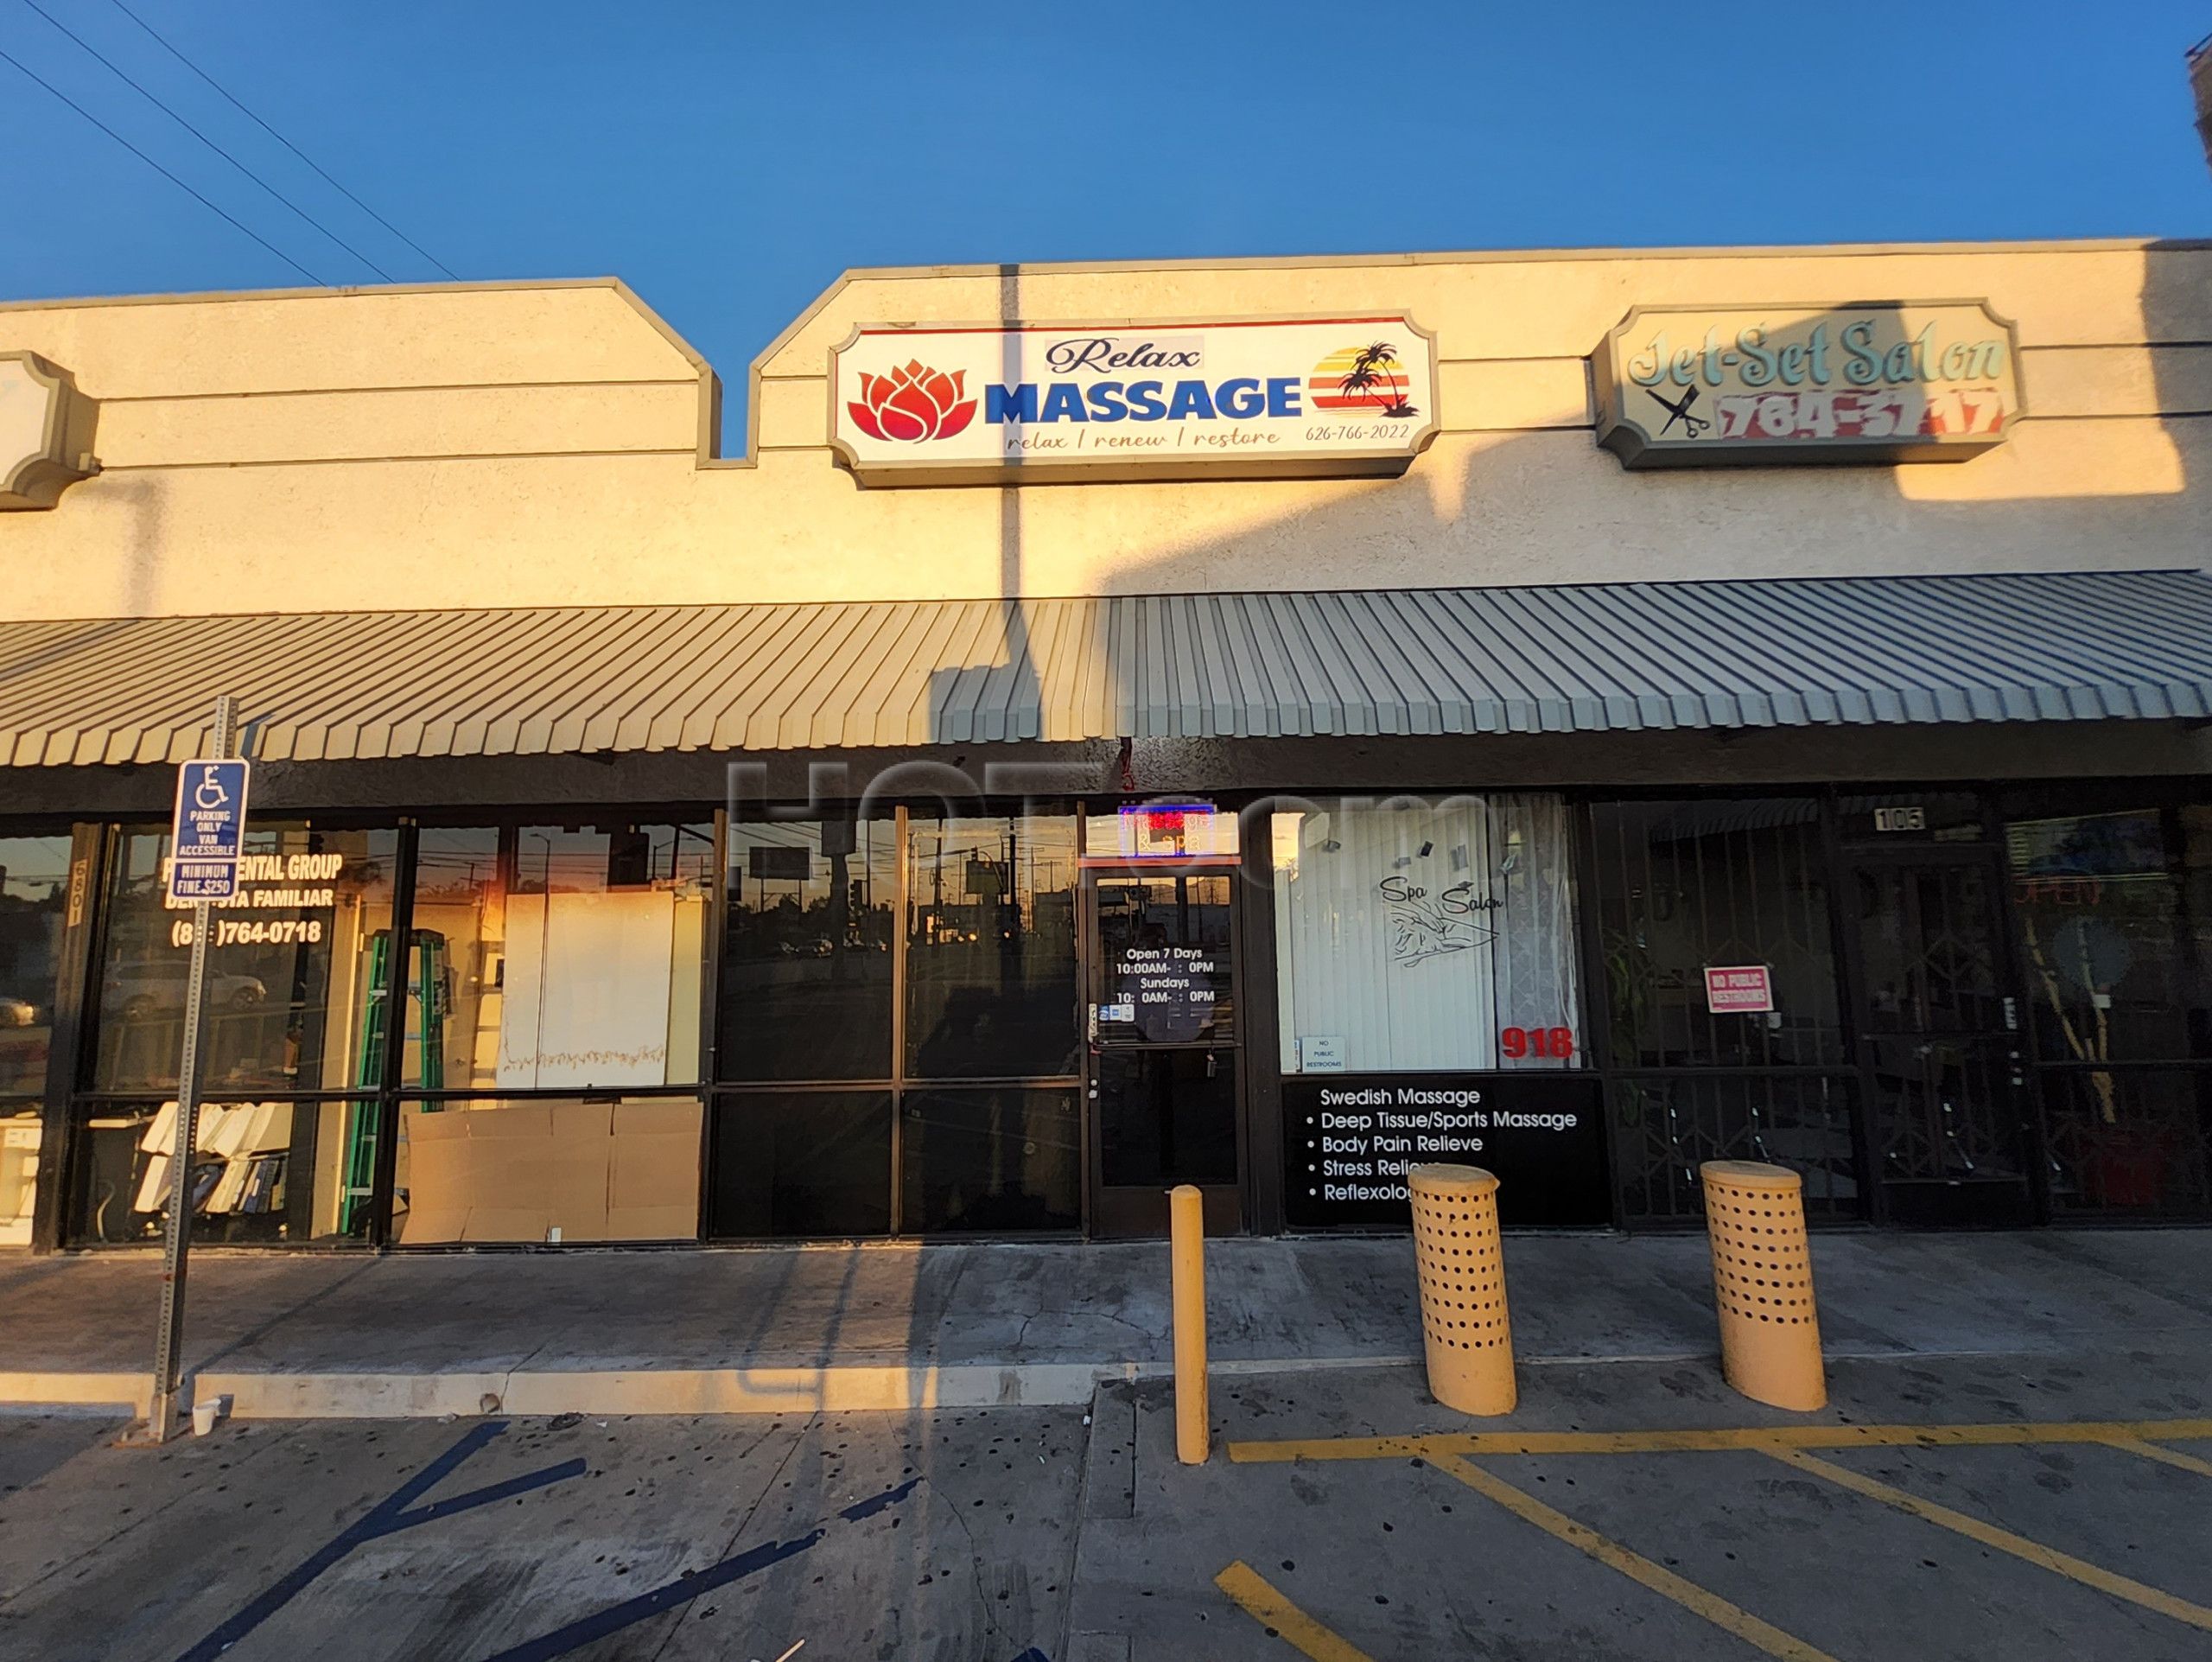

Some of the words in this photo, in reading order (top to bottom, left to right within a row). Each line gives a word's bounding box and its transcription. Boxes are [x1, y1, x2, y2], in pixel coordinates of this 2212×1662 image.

[1046, 338, 1200, 374] Relax
[1627, 322, 1832, 388] Jet-Set
[1843, 320, 2005, 385] Salon
[985, 378, 1301, 423] MASSAGE
[1007, 431, 1068, 450] relax
[1096, 433, 1168, 449] renew
[1194, 426, 1281, 447] restore
[1306, 424, 1410, 442] 626-766-2022
[190, 811, 231, 821] PARKING
[196, 823, 220, 832] ONLY
[199, 835, 218, 844] VAN
[179, 846, 235, 856] ACCESSIBLE
[181, 865, 228, 878] MINIMUM
[238, 855, 284, 881] ENTAL
[288, 854, 343, 880] GROUP
[177, 880, 200, 894] FINE
[1380, 876, 1427, 901] Spa
[252, 888, 334, 907] FAMILIAR
[172, 920, 321, 947] (8)764-0718
[1127, 948, 1160, 960] Open
[1163, 948, 1169, 958] 7
[1173, 947, 1202, 959] Days
[1140, 977, 1190, 990] Sundays
[1502, 1028, 1573, 1059] 918
[1320, 1089, 1392, 1106] Swedish
[1398, 1088, 1481, 1108] Massage
[1321, 1112, 1372, 1130] Deep
[1377, 1111, 1488, 1131] Tissue/Sports
[1493, 1111, 1577, 1131] Massage
[1322, 1137, 1368, 1156] Body
[1374, 1136, 1412, 1152] Pain
[1417, 1136, 1484, 1151] Relieve
[1323, 1159, 1372, 1176] Stress
